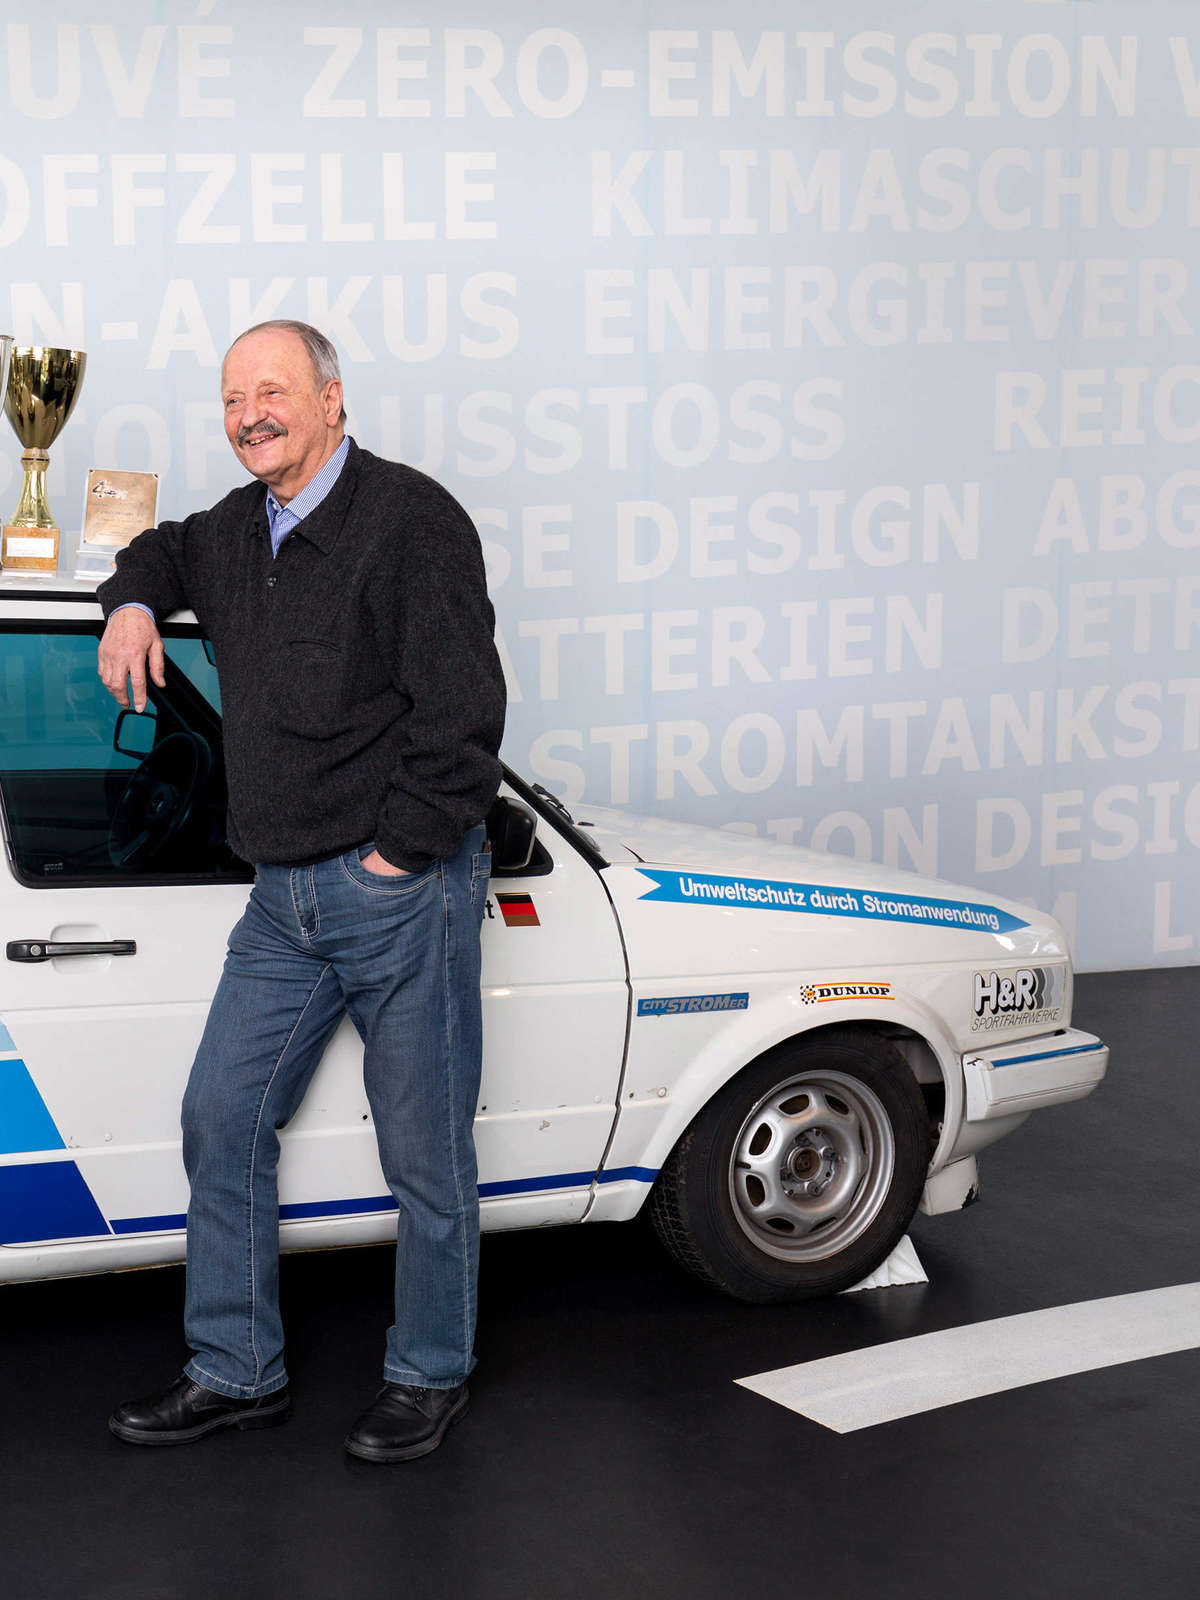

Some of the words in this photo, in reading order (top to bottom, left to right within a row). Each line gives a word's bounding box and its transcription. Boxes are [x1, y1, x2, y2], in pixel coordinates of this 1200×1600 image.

[302, 26, 1138, 119] ZERO-EMISSION
[584, 257, 1194, 357] ENERGIEVER
[615, 481, 981, 583] DESIGN
[1031, 469, 1200, 557] ABG
[679, 877, 806, 906] Umweltschutz
[810, 885, 859, 911] durch
[862, 895, 1000, 930] Stromanwendung
[818, 986, 890, 998] DUNLOP
[971, 1008, 1060, 1031] SPORTFAHRWERKE
[975, 969, 1036, 1016] H&R
